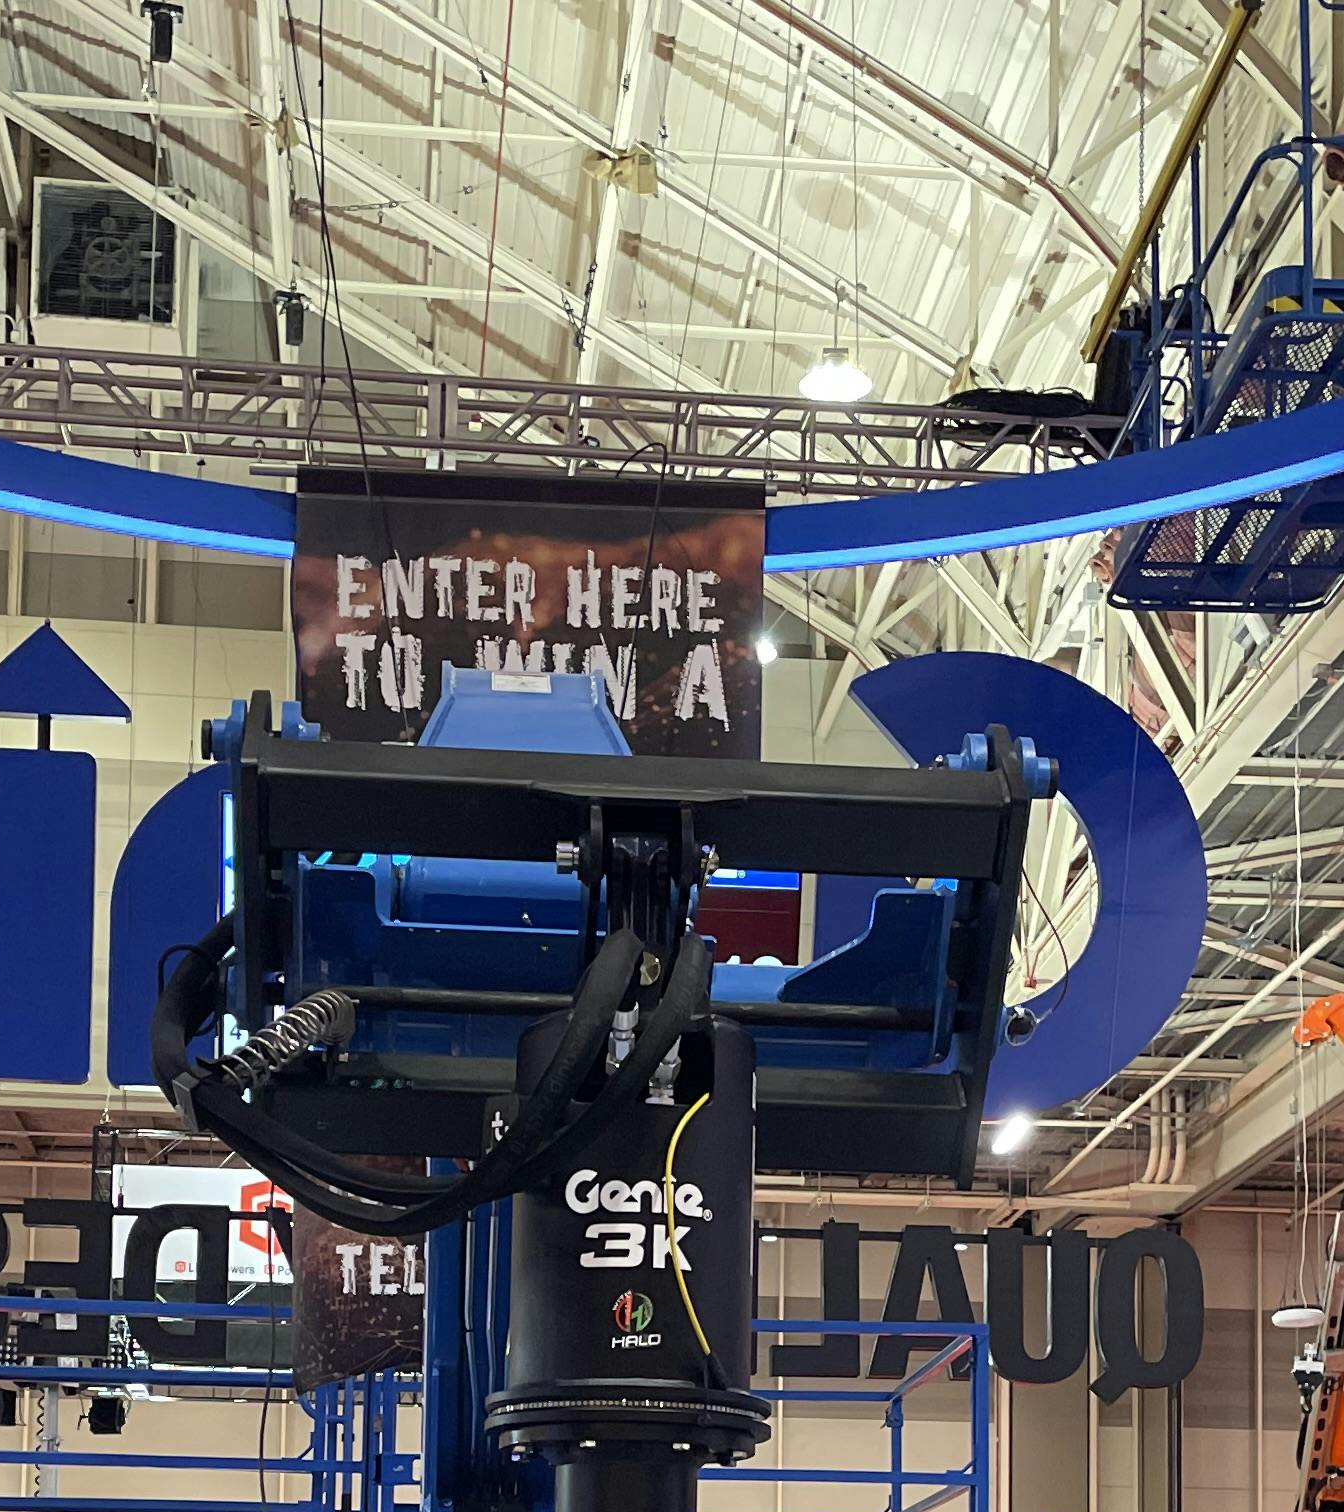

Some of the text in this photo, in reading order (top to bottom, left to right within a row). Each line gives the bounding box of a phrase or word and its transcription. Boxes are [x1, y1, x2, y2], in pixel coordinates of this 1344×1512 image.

[336, 549, 724, 638] ENTER HERE
[336, 627, 426, 712] TO
[673, 641, 730, 731] A
[564, 1168, 706, 1219] Genie
[579, 1222, 692, 1271] 3K
[611, 1333, 662, 1349] HALO
